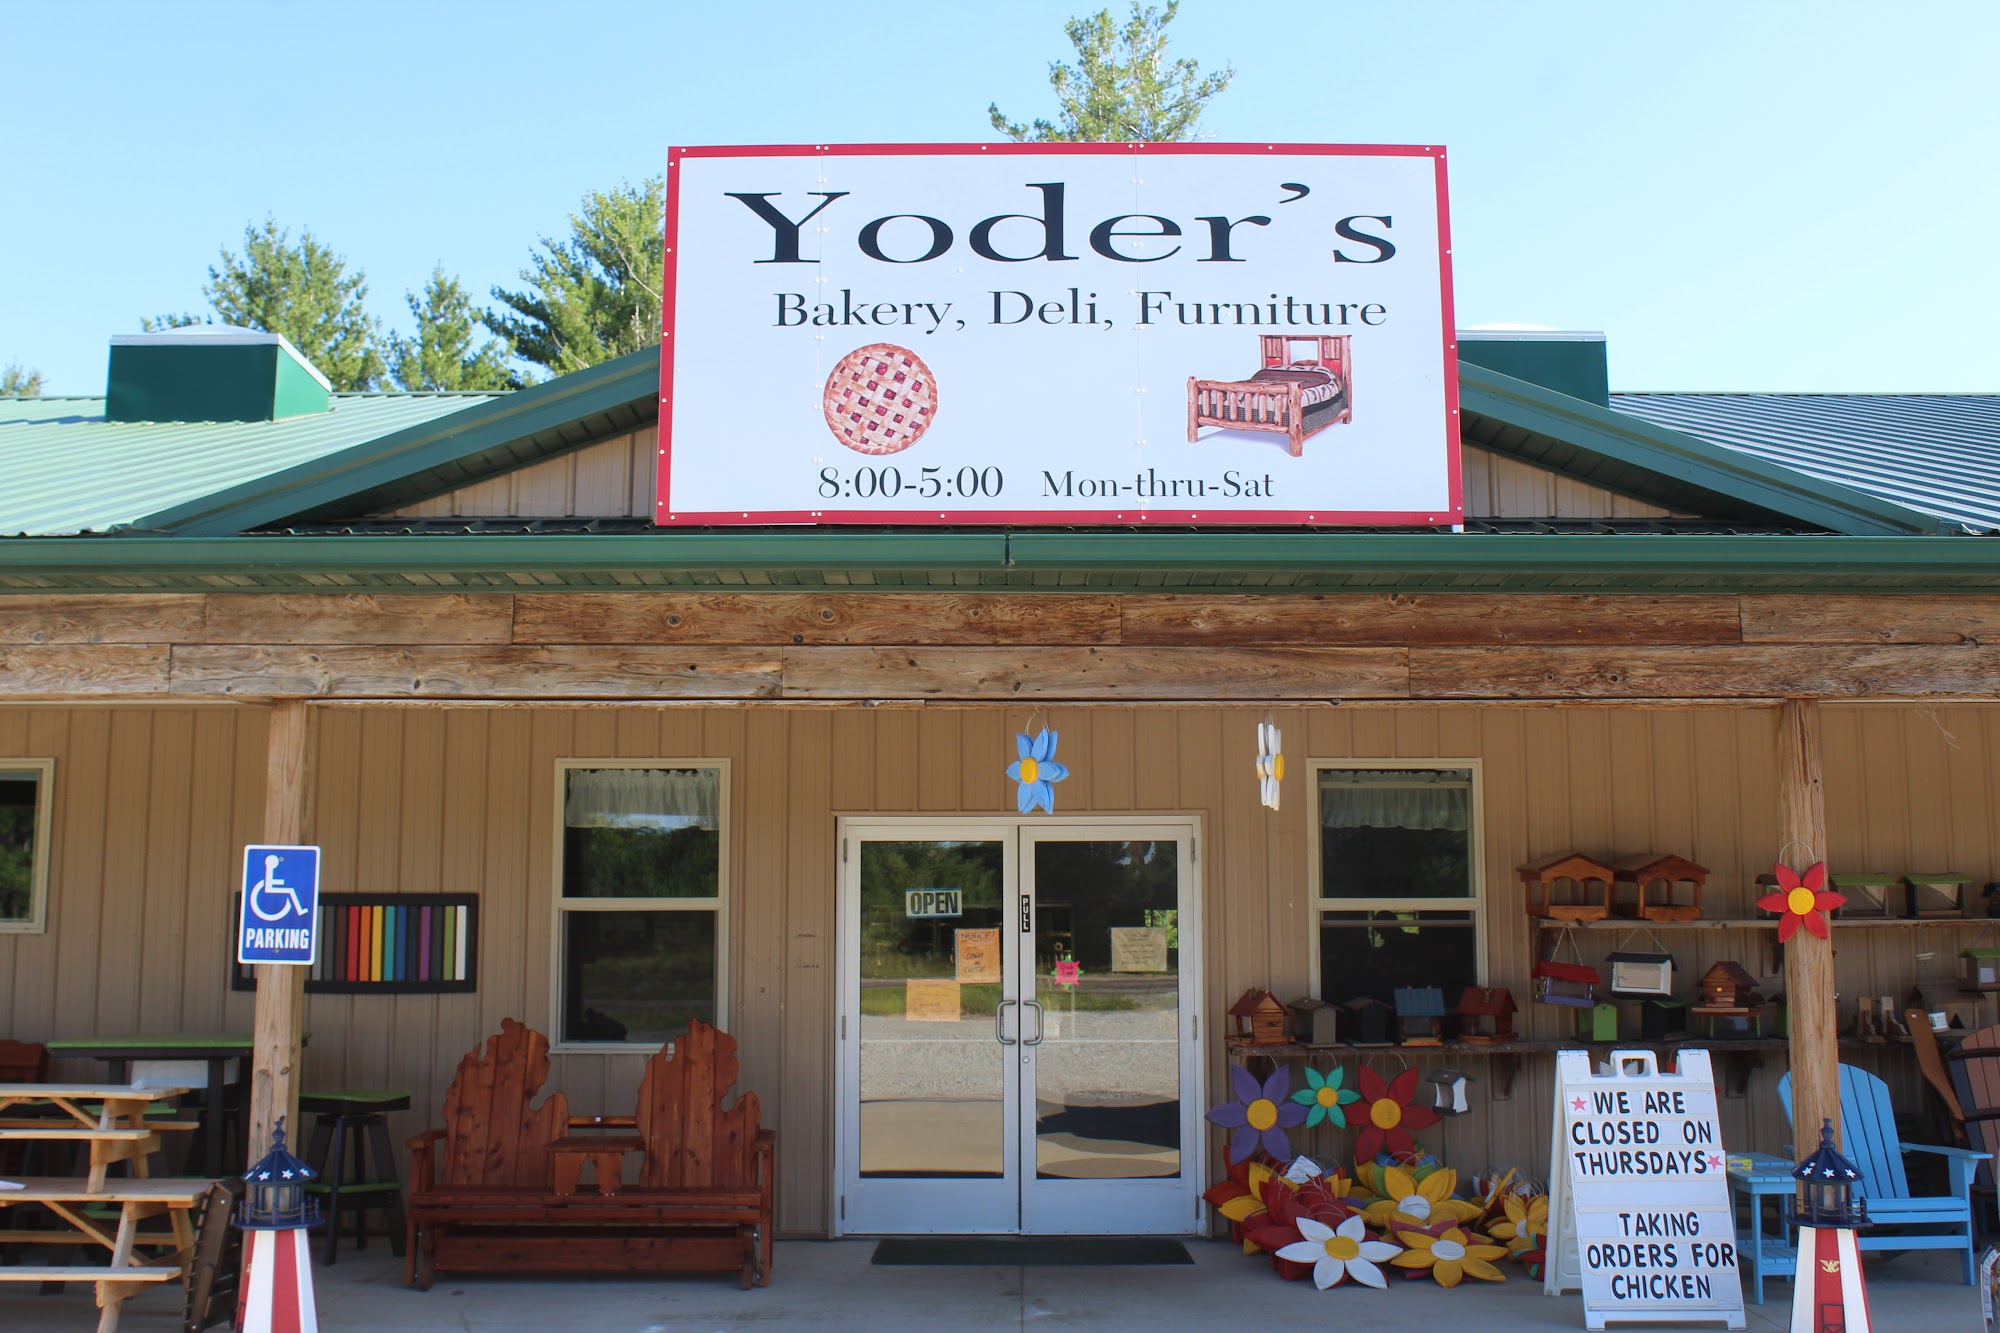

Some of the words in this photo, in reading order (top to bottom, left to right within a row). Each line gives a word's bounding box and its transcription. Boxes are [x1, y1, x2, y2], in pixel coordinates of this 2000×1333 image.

[723, 181, 1396, 264] Yoder's
[772, 288, 965, 335] Bakery,
[986, 287, 1113, 331] Deli,
[1135, 291, 1387, 326] Furniture
[818, 466, 1003, 499] 8:00-5:00
[1042, 468, 1274, 498] Mon-thru-Sat
[910, 892, 958, 914] OPEN
[245, 927, 310, 950] PARKING
[1593, 1091, 1631, 1115] WE
[1644, 1091, 1686, 1115] ARE
[1571, 1120, 1660, 1146] CLOSED
[1682, 1120, 1712, 1145] ON
[1574, 1150, 1707, 1176] THURSDAYS
[1618, 1211, 1700, 1237] TAKING
[1587, 1243, 1678, 1269] ORDERS
[1691, 1242, 1735, 1268] FOR
[1611, 1274, 1712, 1300] CHICKEN
